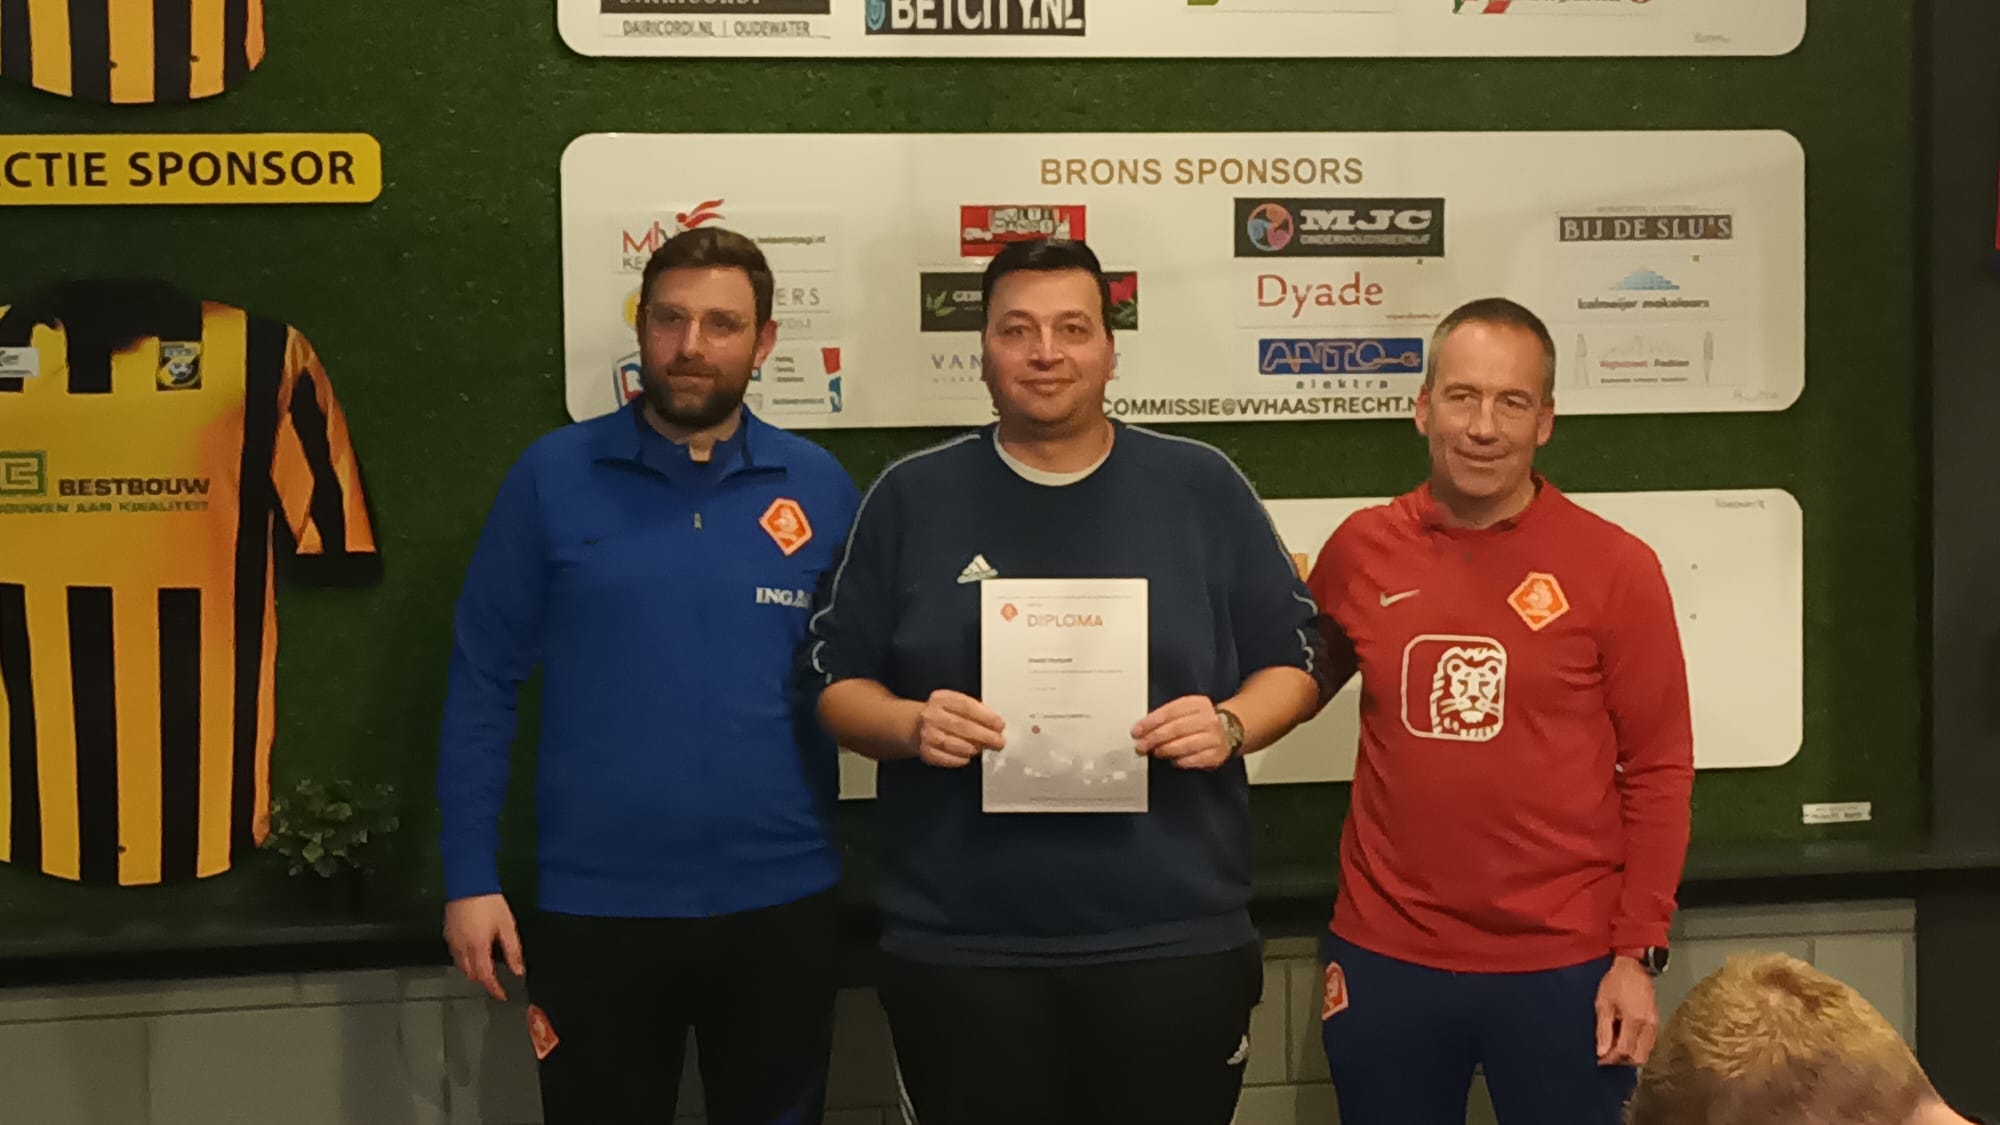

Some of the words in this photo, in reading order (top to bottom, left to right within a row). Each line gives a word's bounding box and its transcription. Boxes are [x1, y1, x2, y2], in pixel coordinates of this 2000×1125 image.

[733, 20, 811, 37] OUDEWATER
[0, 152, 108, 188] CTIE
[128, 150, 356, 187] SPONSOR
[1041, 158, 1163, 185] BRONS
[1173, 157, 1364, 185] SPONSORS
[1299, 209, 1433, 231] MJC
[1563, 219, 1603, 239] BIJ
[1613, 218, 1647, 239] DE
[1257, 271, 1384, 319] Dyade
[59, 478, 210, 496] BESTBOUW
[755, 587, 793, 606] ING
[1027, 613, 1104, 628] DIPLOMA
